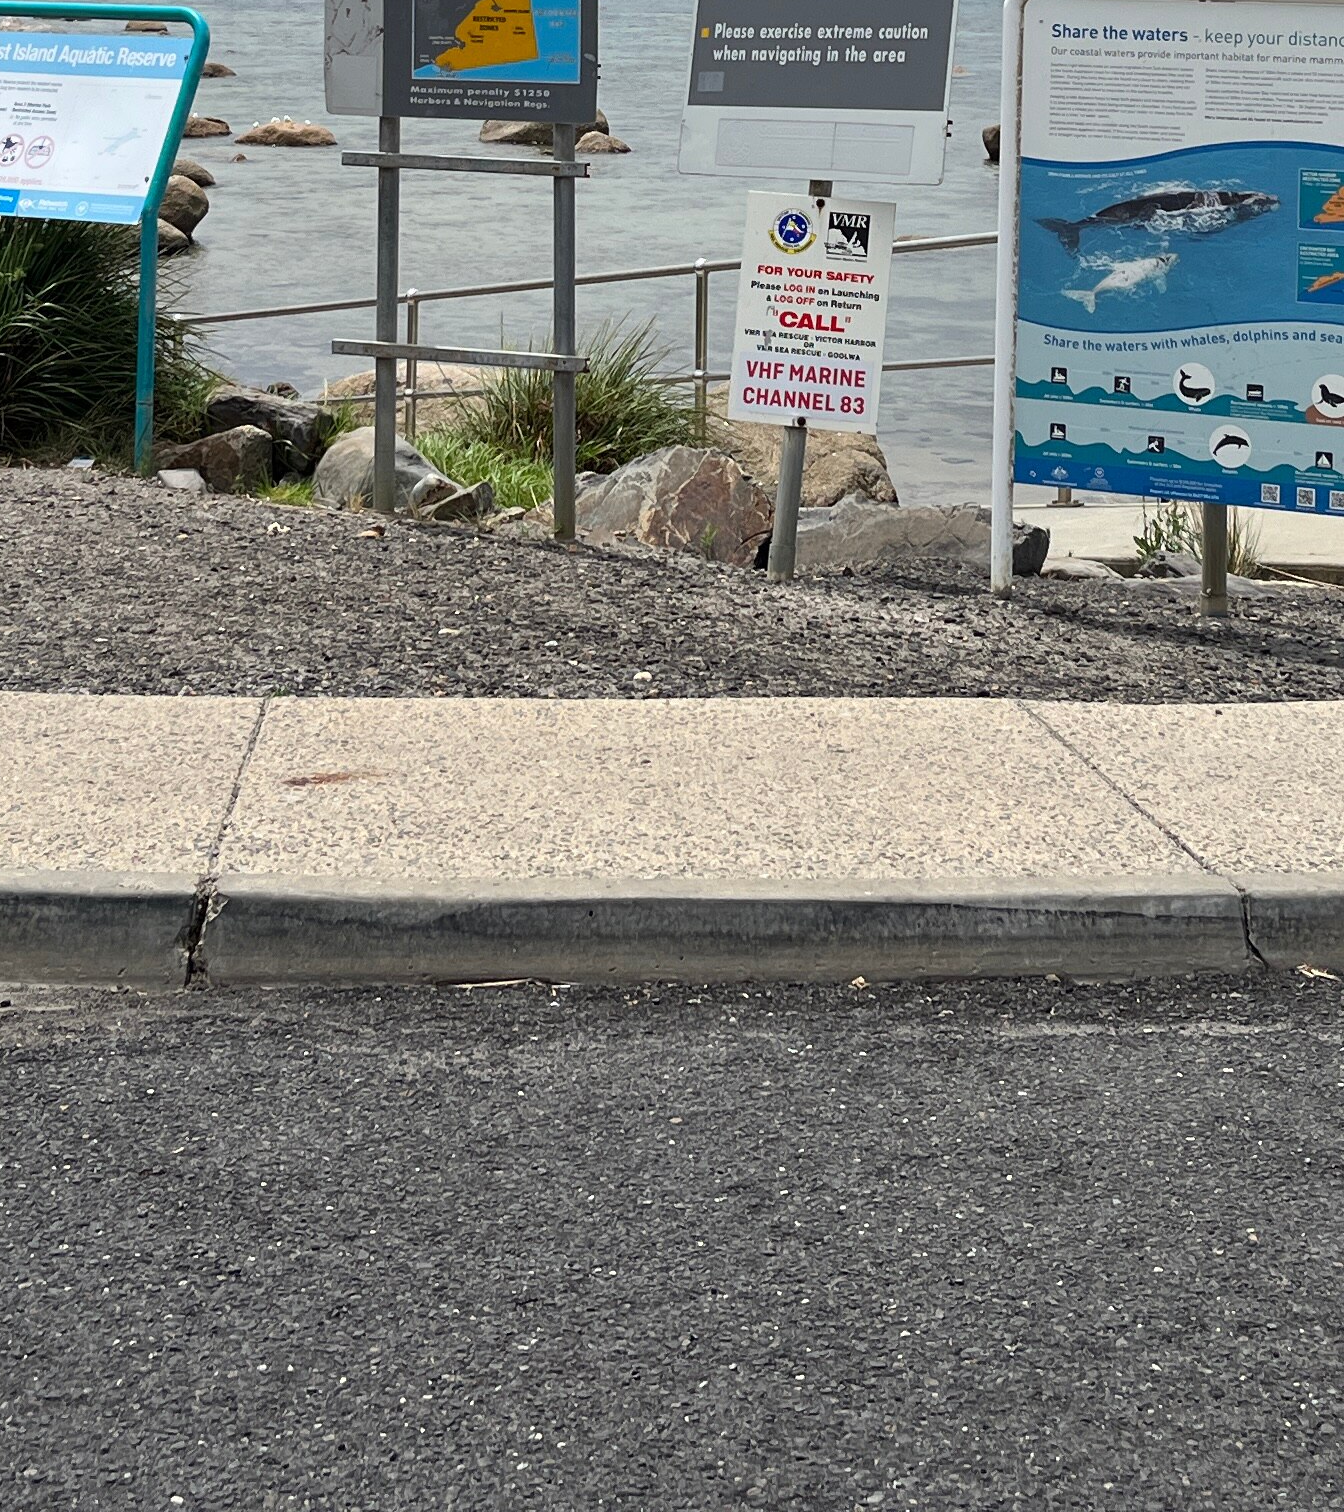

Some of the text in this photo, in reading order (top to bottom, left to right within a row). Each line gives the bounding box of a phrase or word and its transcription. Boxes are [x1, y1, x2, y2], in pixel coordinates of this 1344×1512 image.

[715, 23, 928, 39] Please exercise extreme caution
[1051, 23, 1100, 42] Share
[1102, 25, 1129, 42] the
[1132, 28, 1188, 41] waters
[1205, 29, 1242, 47] keep
[1248, 31, 1284, 47] your
[13, 43, 58, 62] Island
[58, 45, 114, 67] Aquatic
[117, 47, 176, 67] Reserve
[411, 86, 549, 97] Maximum penalty $1250
[832, 213, 868, 229] VMR
[758, 265, 874, 284] FOR YOUR SAFETY
[751, 281, 781, 291] Please
[784, 284, 802, 292] LOG
[805, 286, 816, 294] IN
[832, 288, 879, 301] Launching
[774, 294, 793, 303] LOG
[796, 297, 815, 305] OFF
[817, 299, 828, 307] on
[831, 300, 861, 310] Return
[1044, 334, 1079, 349] Share
[1083, 340, 1102, 351] the
[1105, 338, 1148, 352] waters
[1152, 335, 1178, 350] with
[1181, 334, 1229, 347] whales,
[1233, 330, 1288, 343] dolphins
[1292, 328, 1316, 342] and
[747, 361, 865, 387] VHF MARINE
[743, 387, 864, 414] CHANNEL 83
